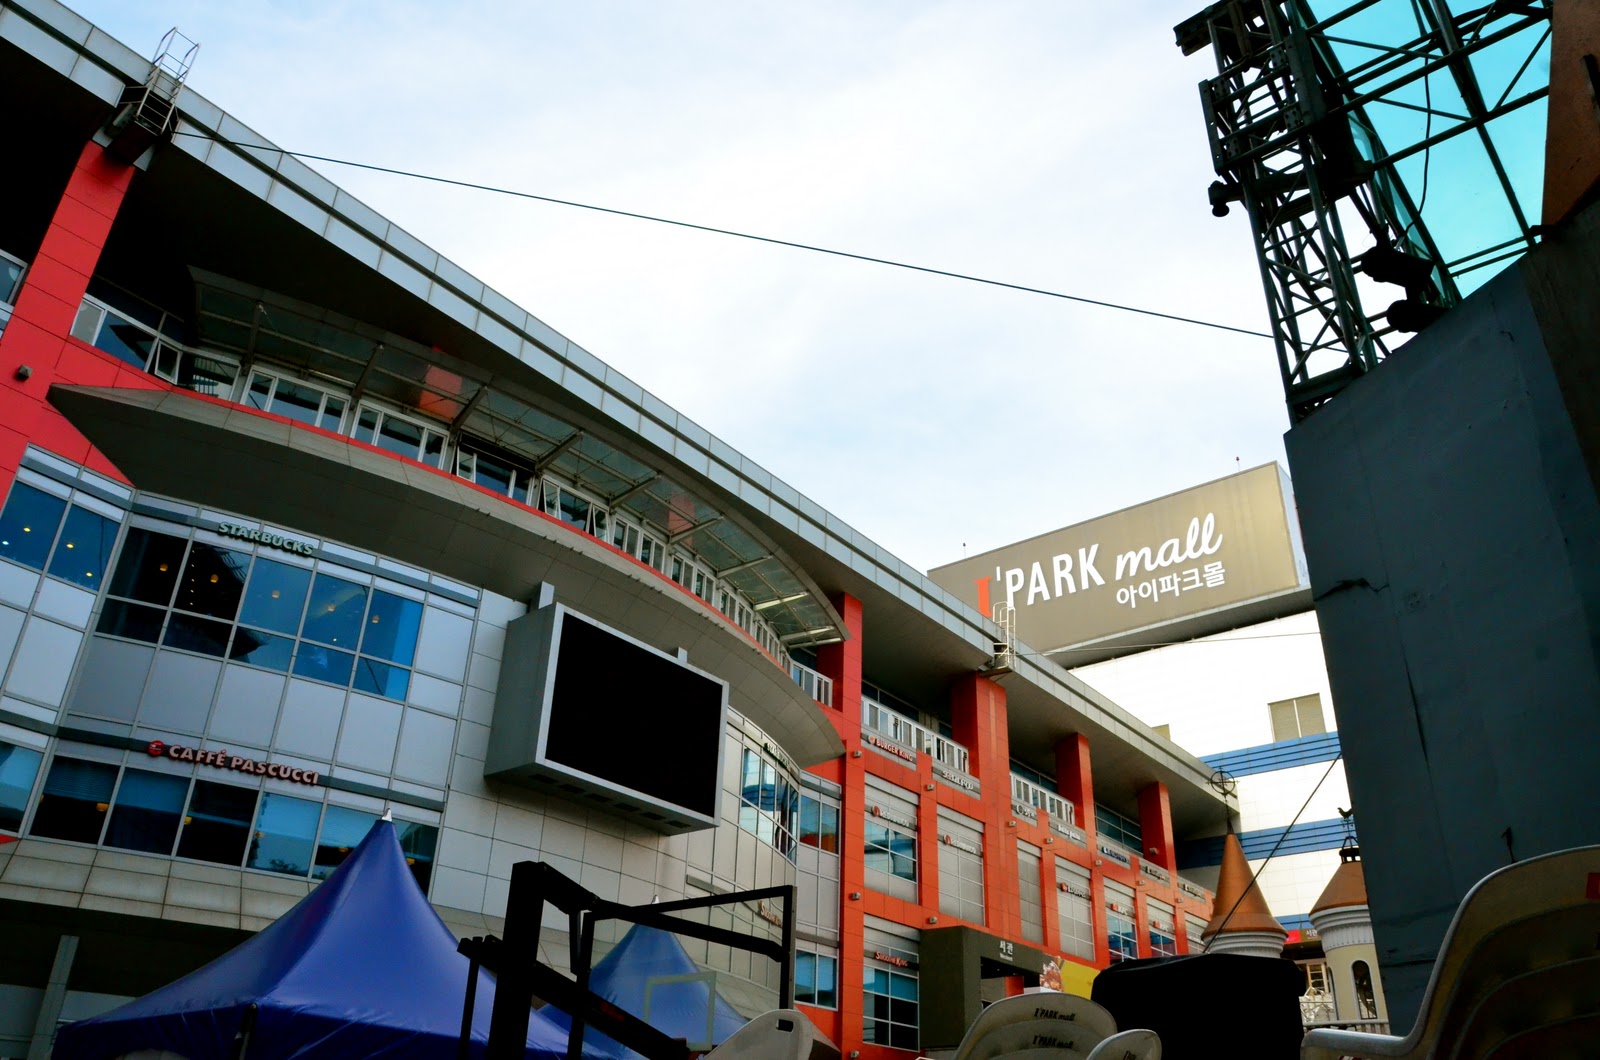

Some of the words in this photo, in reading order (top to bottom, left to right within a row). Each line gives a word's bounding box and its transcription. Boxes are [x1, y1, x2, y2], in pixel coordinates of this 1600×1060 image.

[218, 521, 314, 556] STARBUCKS
[975, 543, 1106, 618] I'PARK
[1115, 512, 1223, 581] mall
[1116, 561, 1226, 609] 아이파크몰
[168, 744, 227, 767] CAFFÉ
[230, 755, 320, 785] PASCUCCI
[875, 737, 899, 755] BURGER
[899, 748, 914, 762] KING
[999, 940, 1013, 956] 서관
[1058, 1012, 1076, 1021] mall
